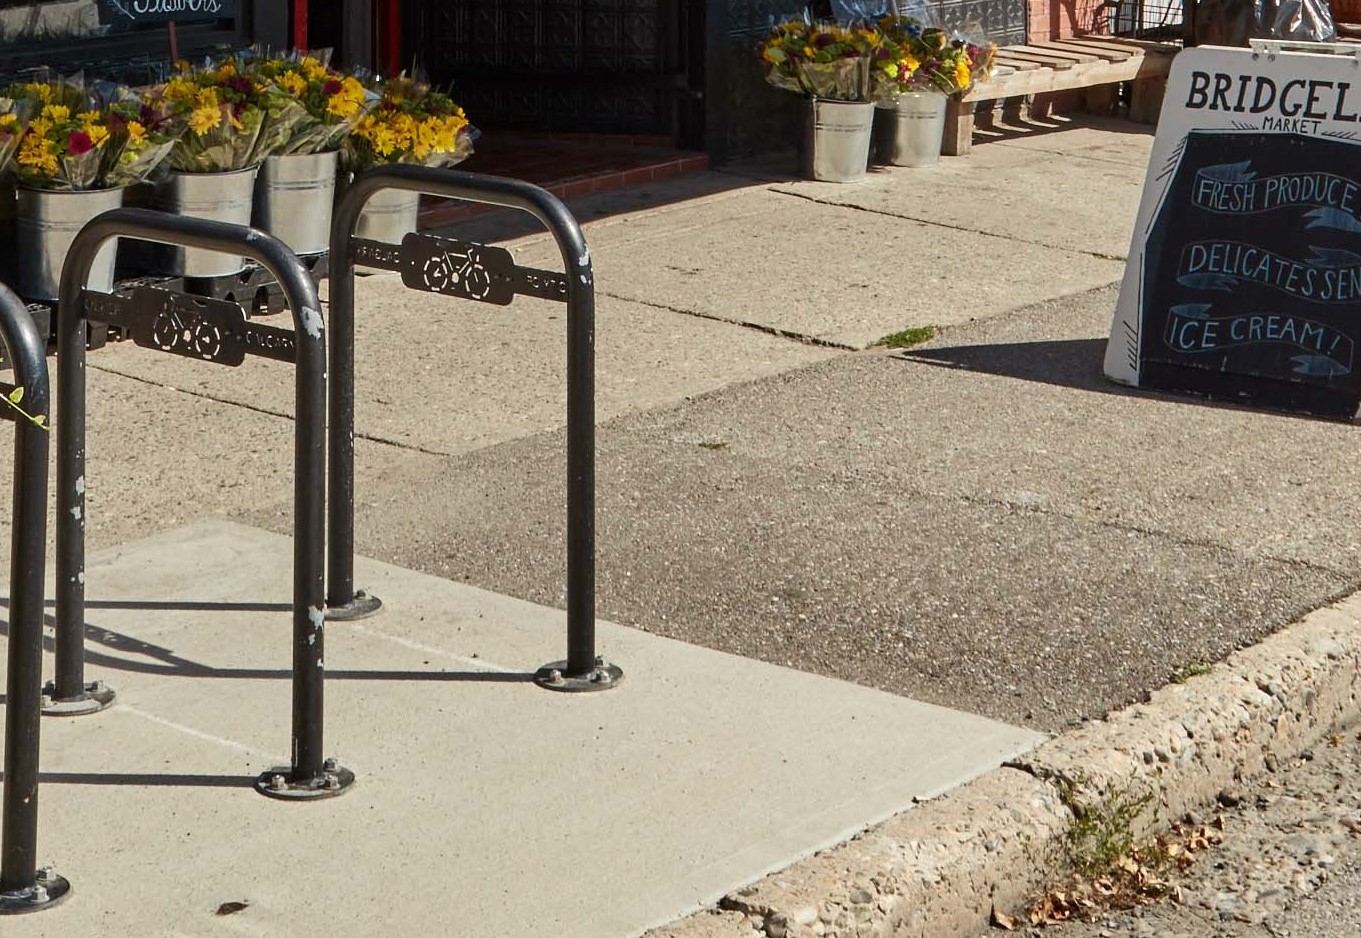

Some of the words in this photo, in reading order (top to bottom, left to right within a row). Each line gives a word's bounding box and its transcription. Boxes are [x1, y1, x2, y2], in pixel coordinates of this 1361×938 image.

[1262, 116, 1322, 135] MARKET
[1197, 179, 1256, 211] FRESH
[1170, 317, 1220, 349] ICE
[1231, 315, 1341, 355] CREAM!
